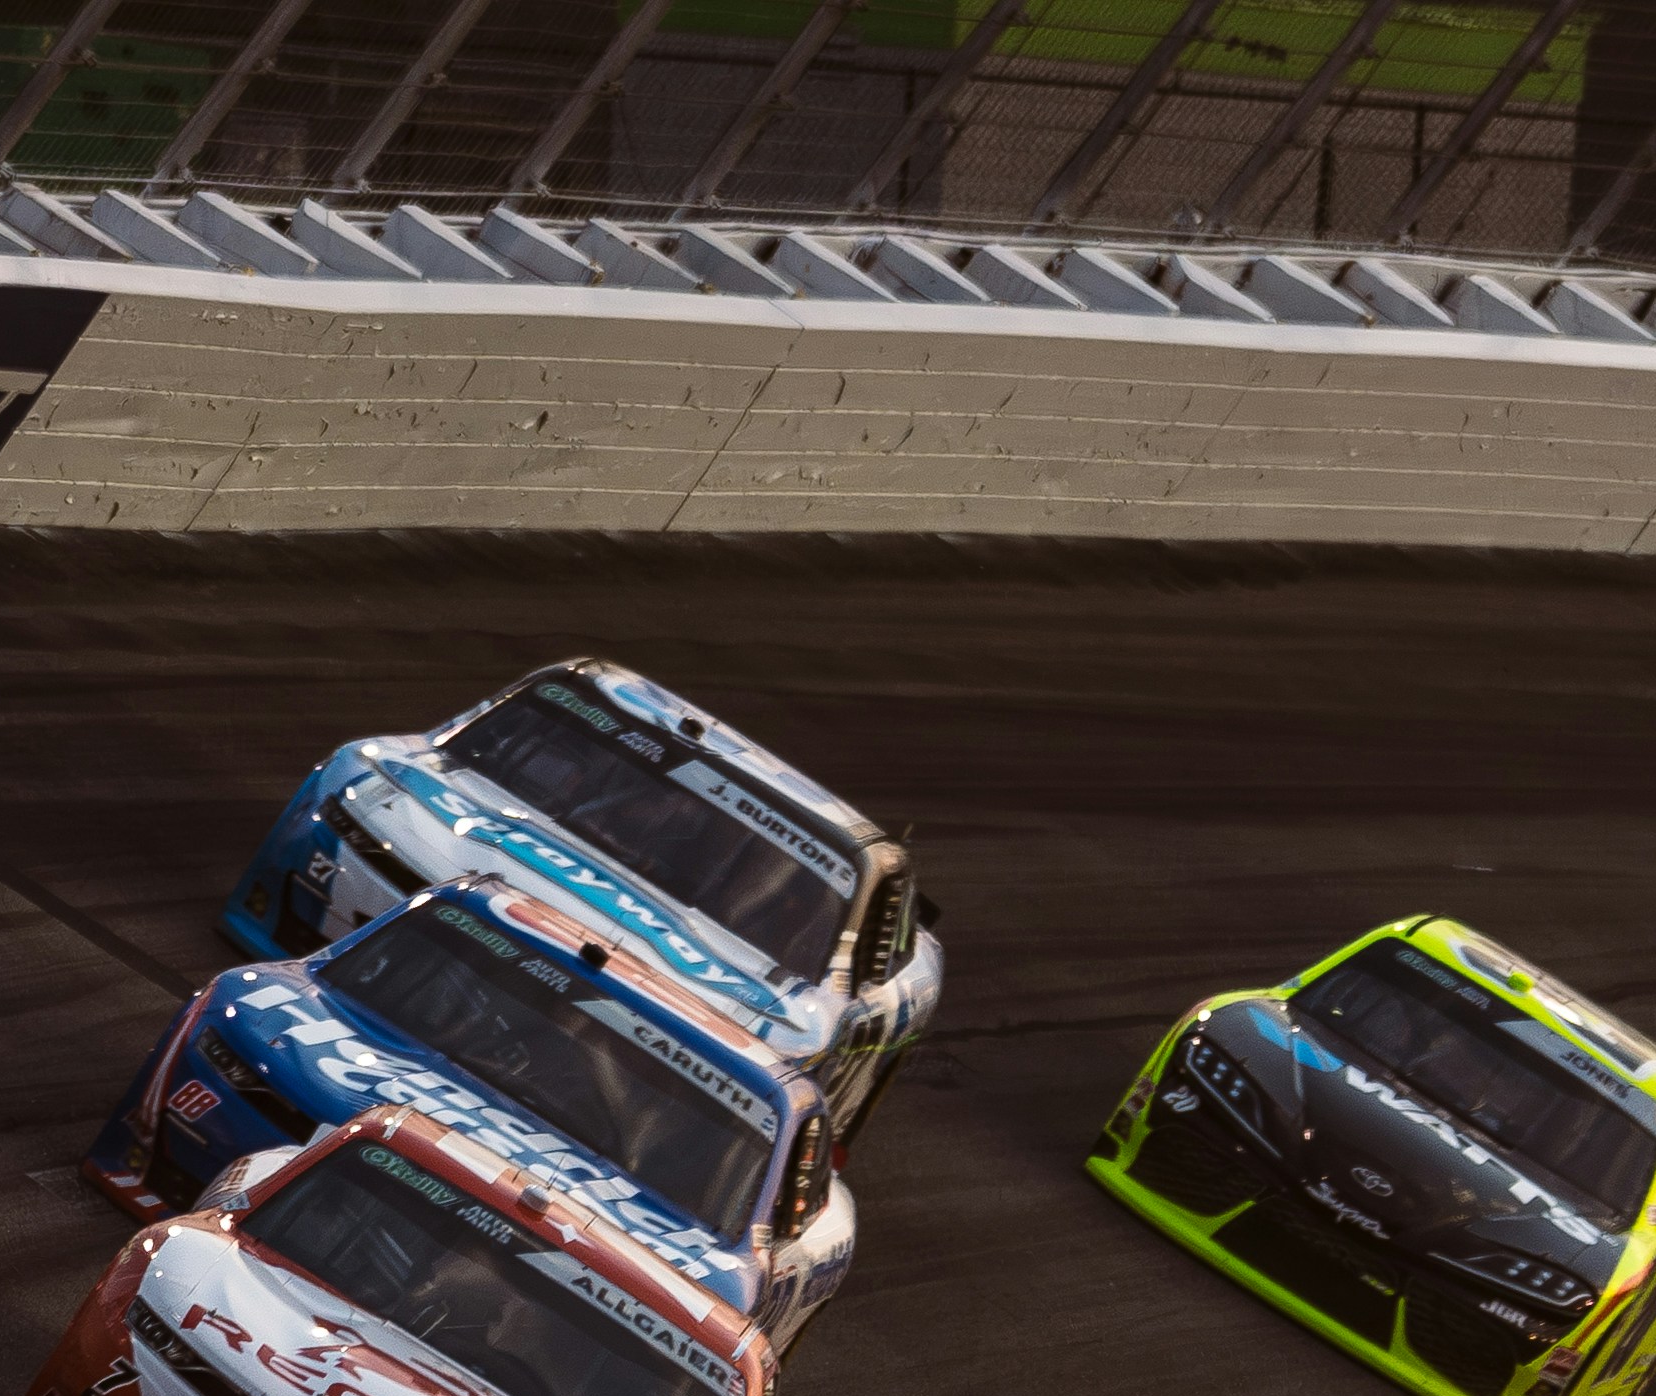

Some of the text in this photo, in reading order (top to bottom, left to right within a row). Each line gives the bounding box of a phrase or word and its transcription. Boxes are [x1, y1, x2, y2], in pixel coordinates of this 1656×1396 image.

[706, 784, 835, 873] J. BURTON
[308, 851, 337, 884] 27
[632, 1027, 754, 1108] CARUTH
[172, 1081, 221, 1118] 88
[1162, 1086, 1199, 1113] 20
[1346, 1065, 1599, 1245] WATTS
[571, 1275, 731, 1383] ALLGAIER
[90, 1357, 139, 1396] 7
